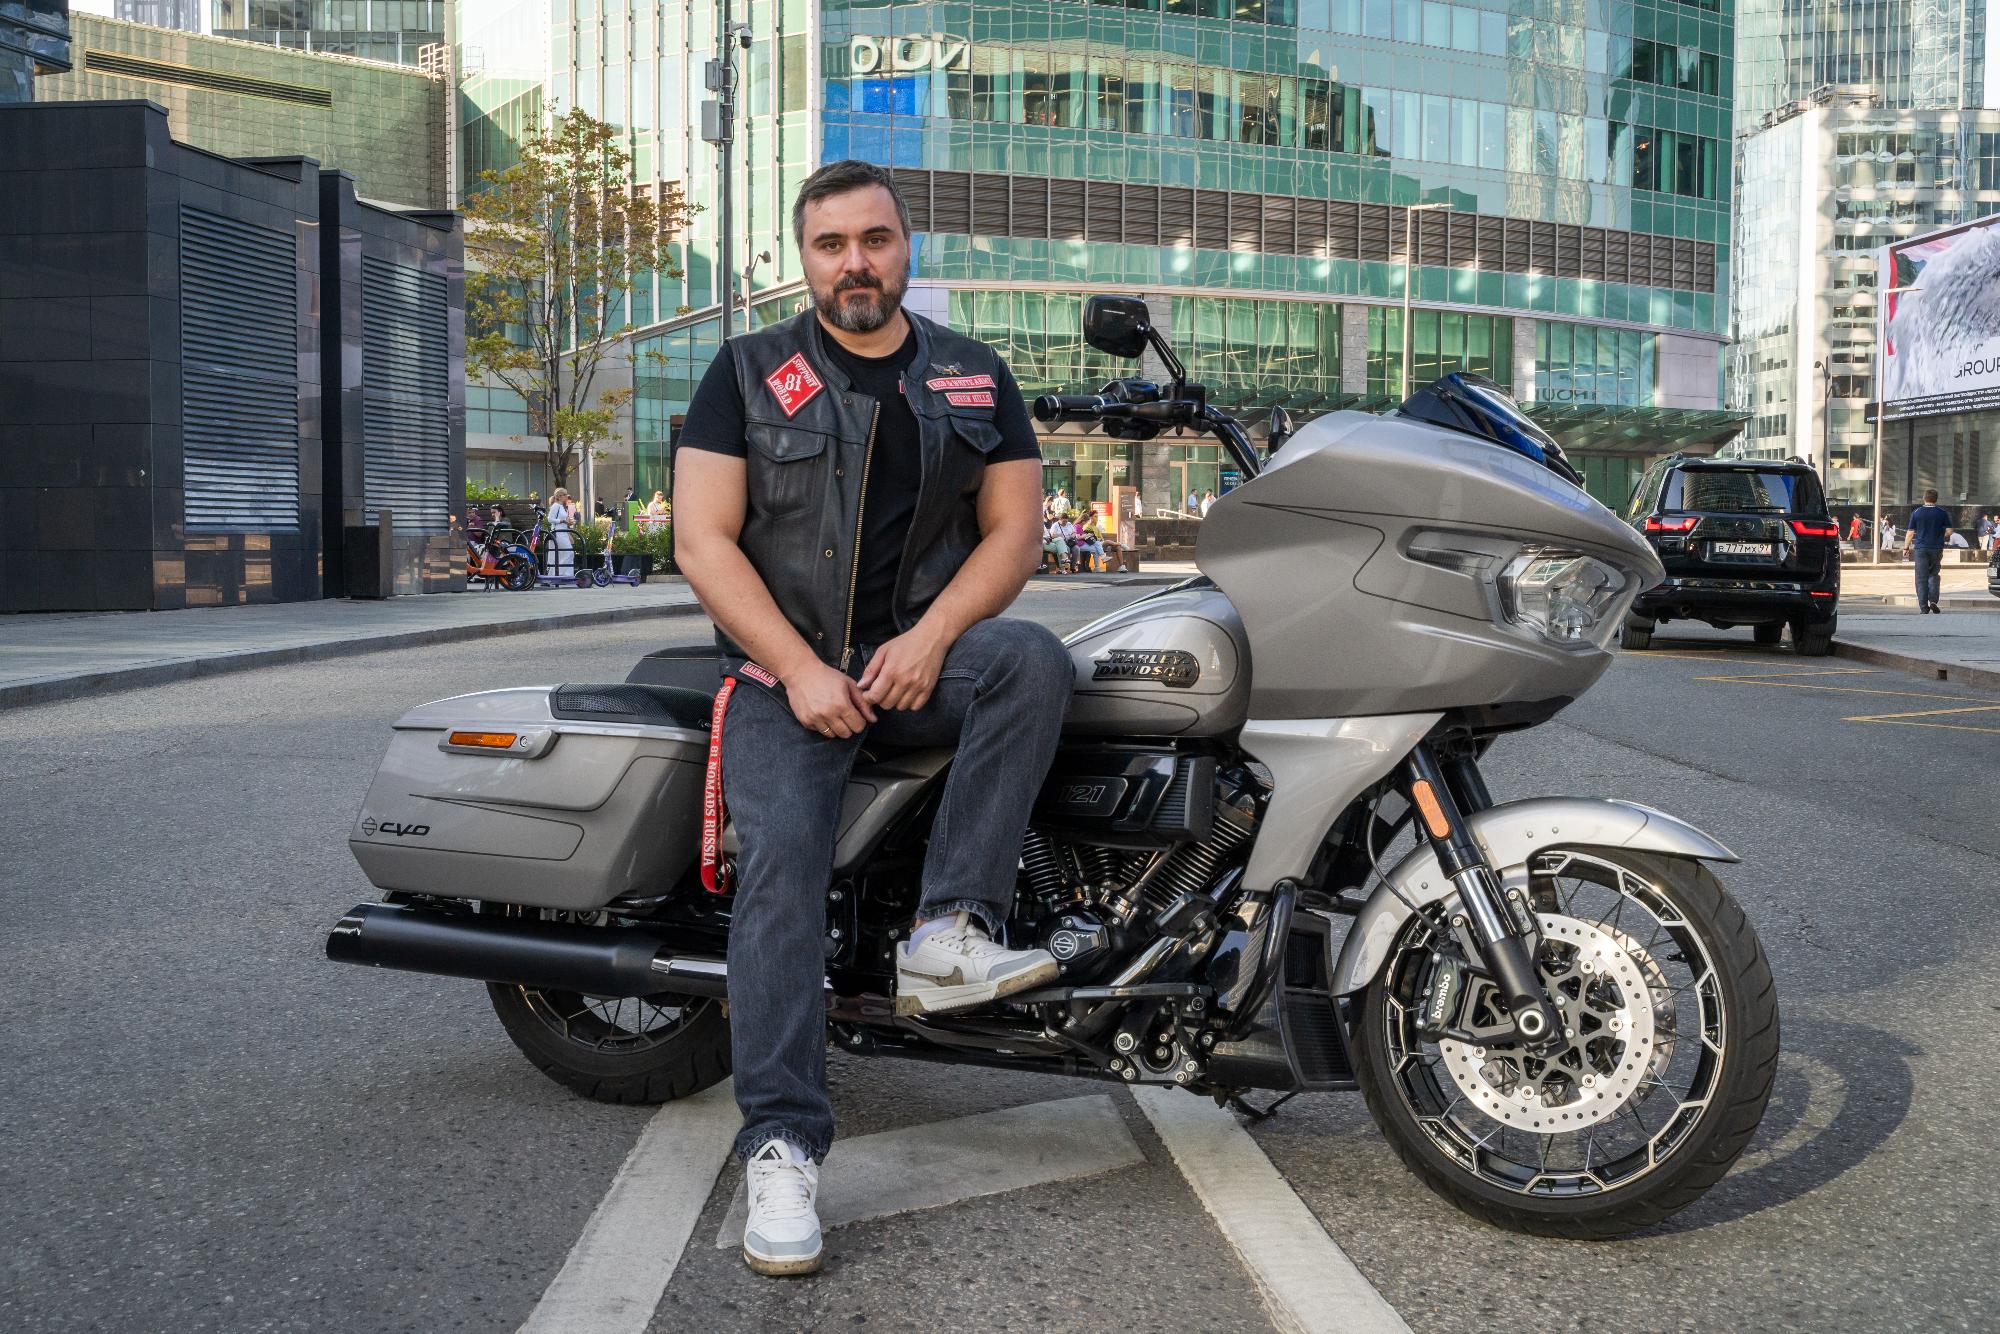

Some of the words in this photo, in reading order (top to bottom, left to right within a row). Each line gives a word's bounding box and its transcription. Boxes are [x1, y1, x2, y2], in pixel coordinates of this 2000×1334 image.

[784, 373, 801, 391] 81
[793, 358, 818, 387] SUPPORT
[771, 378, 793, 405] WORLD
[972, 394, 991, 403] HILLS
[744, 663, 777, 685] SAKHALIN
[1100, 664, 1193, 678] DAVIDSON
[712, 685, 731, 739] SUPPORT
[705, 761, 717, 817] NOMADS
[379, 821, 431, 837] CVO
[703, 819, 716, 867] RUSSIA
[1431, 974, 1451, 1020] brembo
